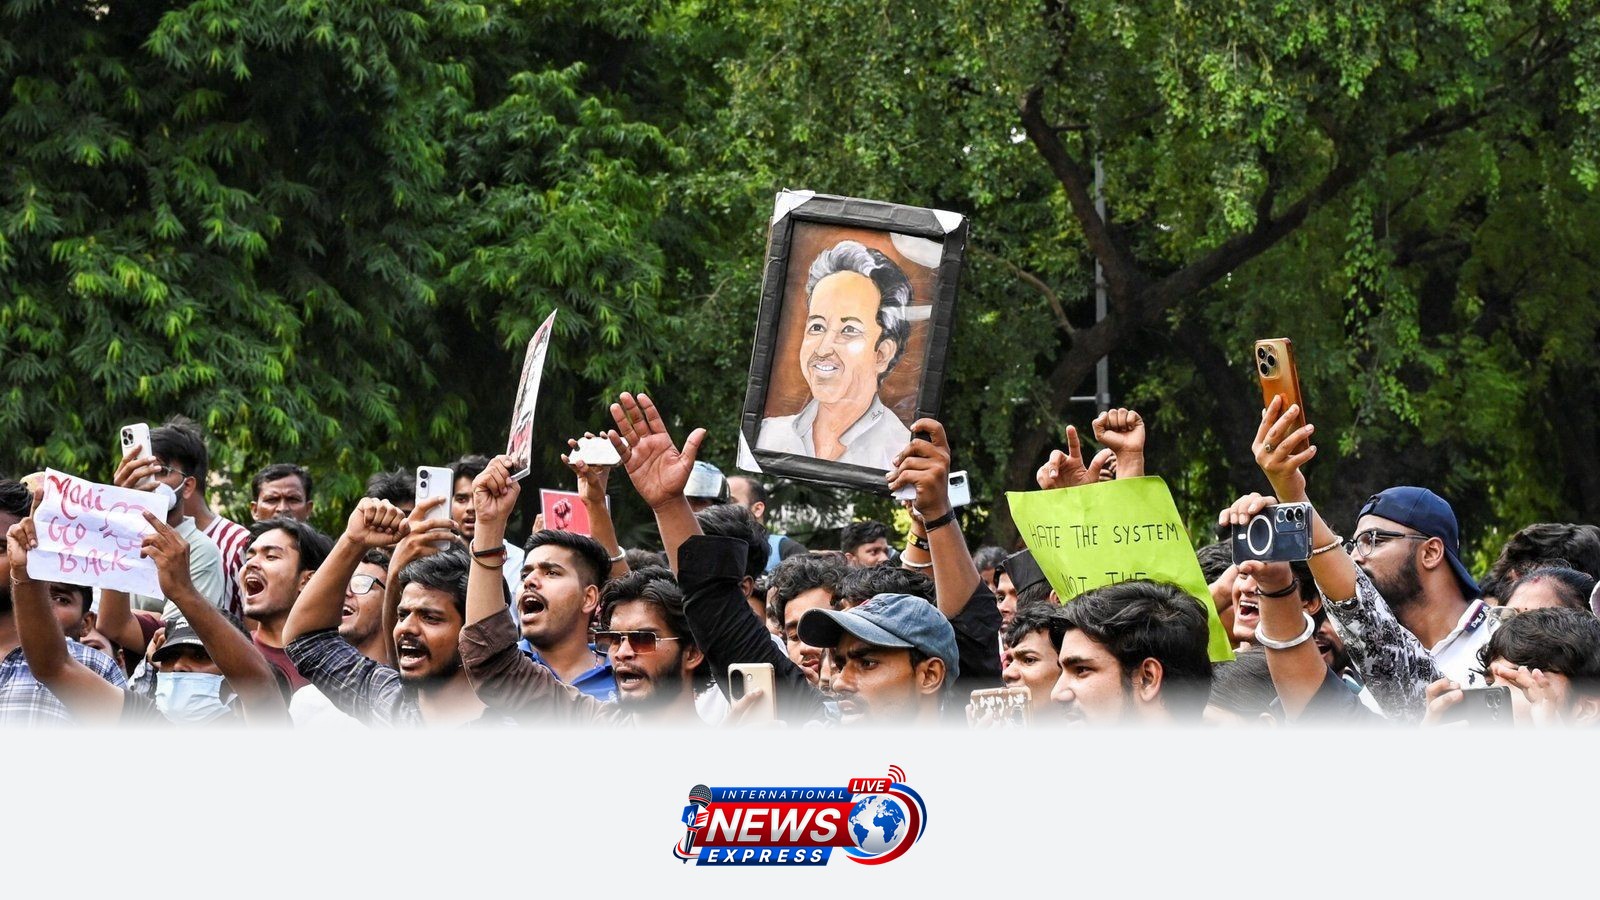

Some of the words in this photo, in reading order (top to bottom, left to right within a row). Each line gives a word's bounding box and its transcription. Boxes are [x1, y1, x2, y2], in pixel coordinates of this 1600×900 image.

[1028, 523, 1061, 548] HATE
[1069, 525, 1099, 549] THE
[1113, 522, 1180, 545] SYSTEM
[58, 547, 131, 576] BACK
[1060, 572, 1088, 595] NOT
